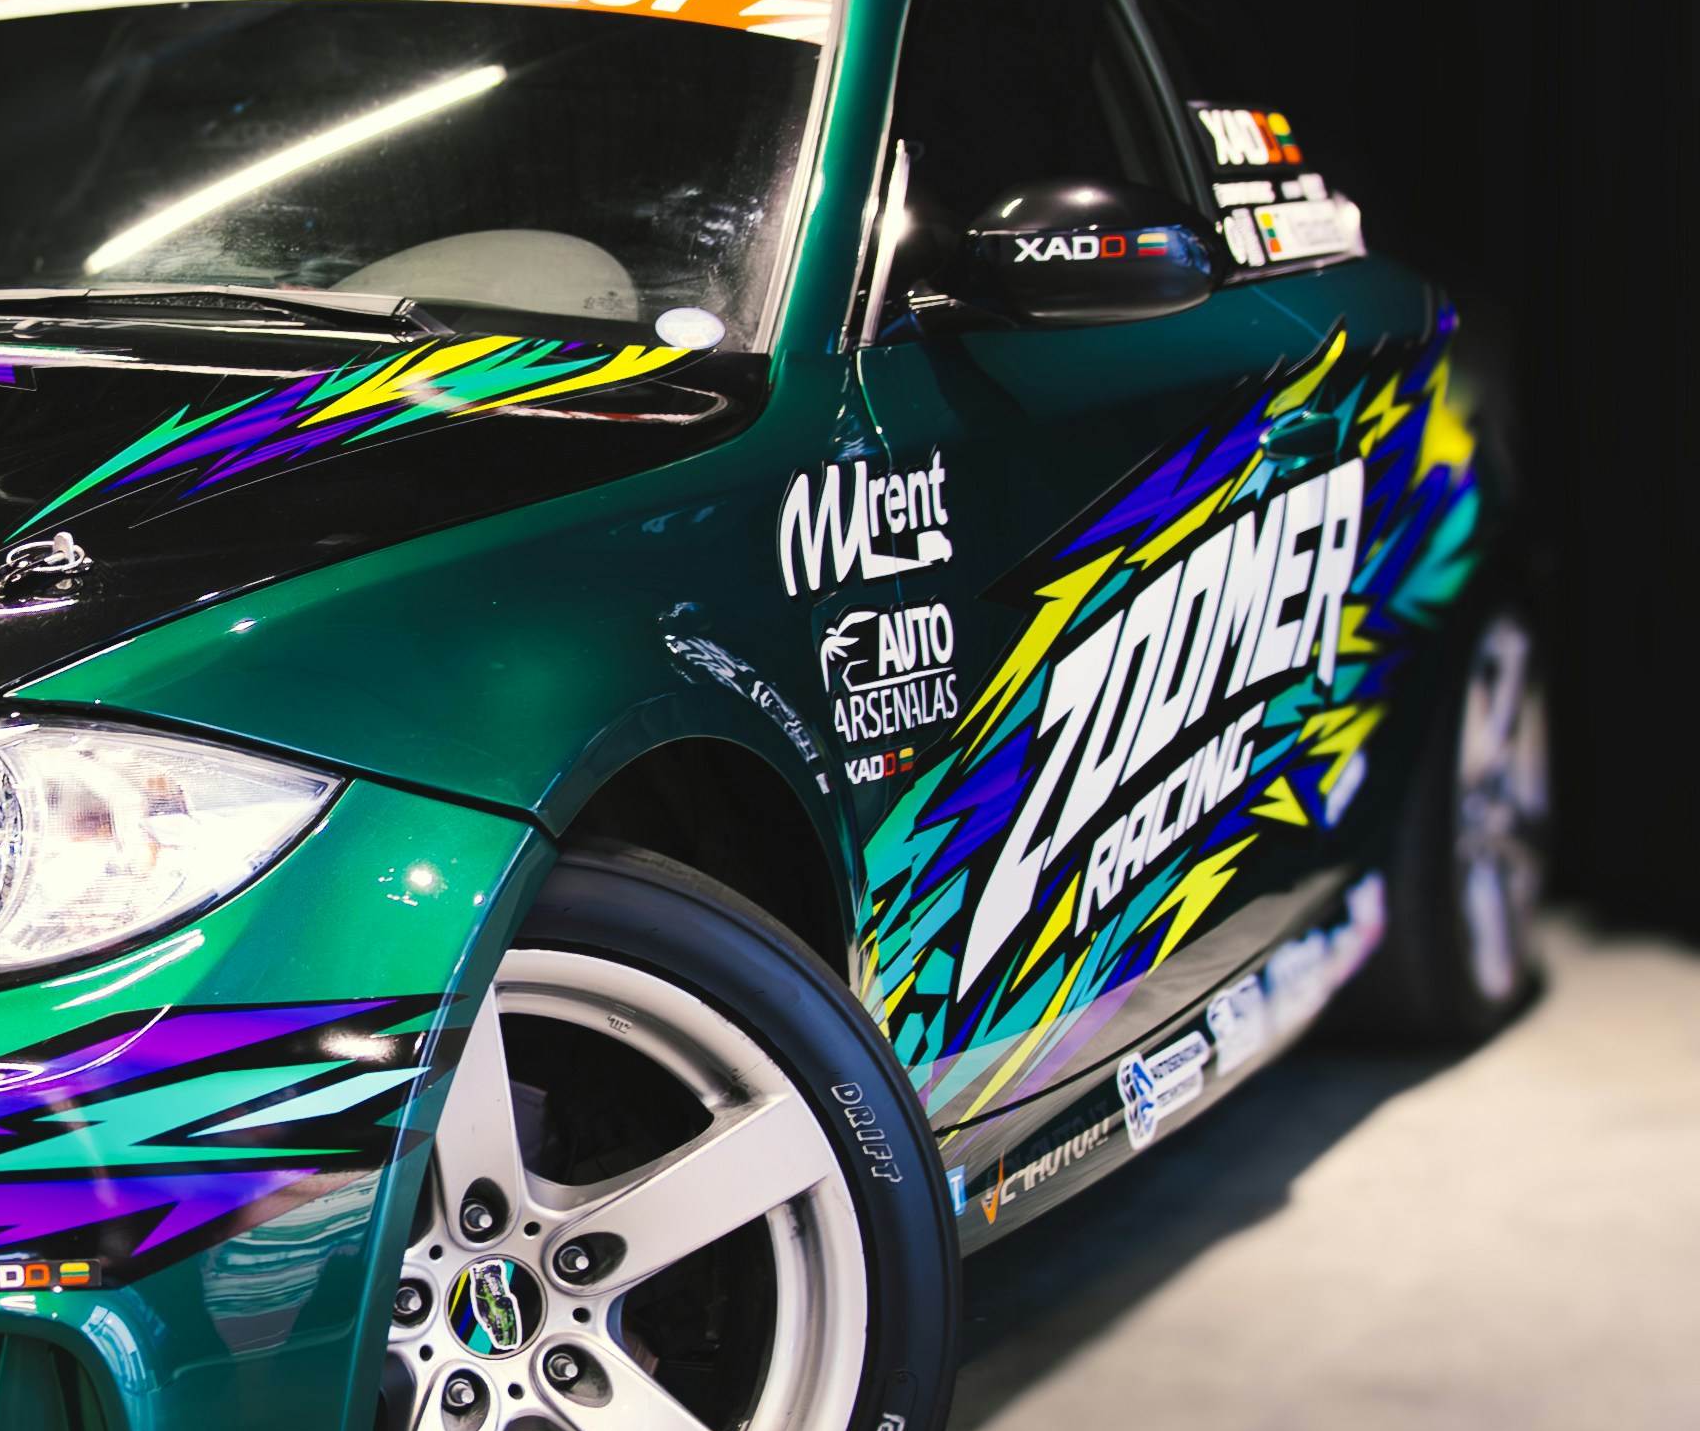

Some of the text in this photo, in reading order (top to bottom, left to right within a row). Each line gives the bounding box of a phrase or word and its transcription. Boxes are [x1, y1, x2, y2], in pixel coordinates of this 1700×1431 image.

[1014, 235, 1126, 262] XADO
[878, 603, 954, 677] AUTO
[834, 673, 958, 743] ARSENALAS
[957, 458, 1365, 1004] ZOOMER
[1075, 701, 1266, 938] RACING
[830, 1081, 904, 1183] DRIFT
